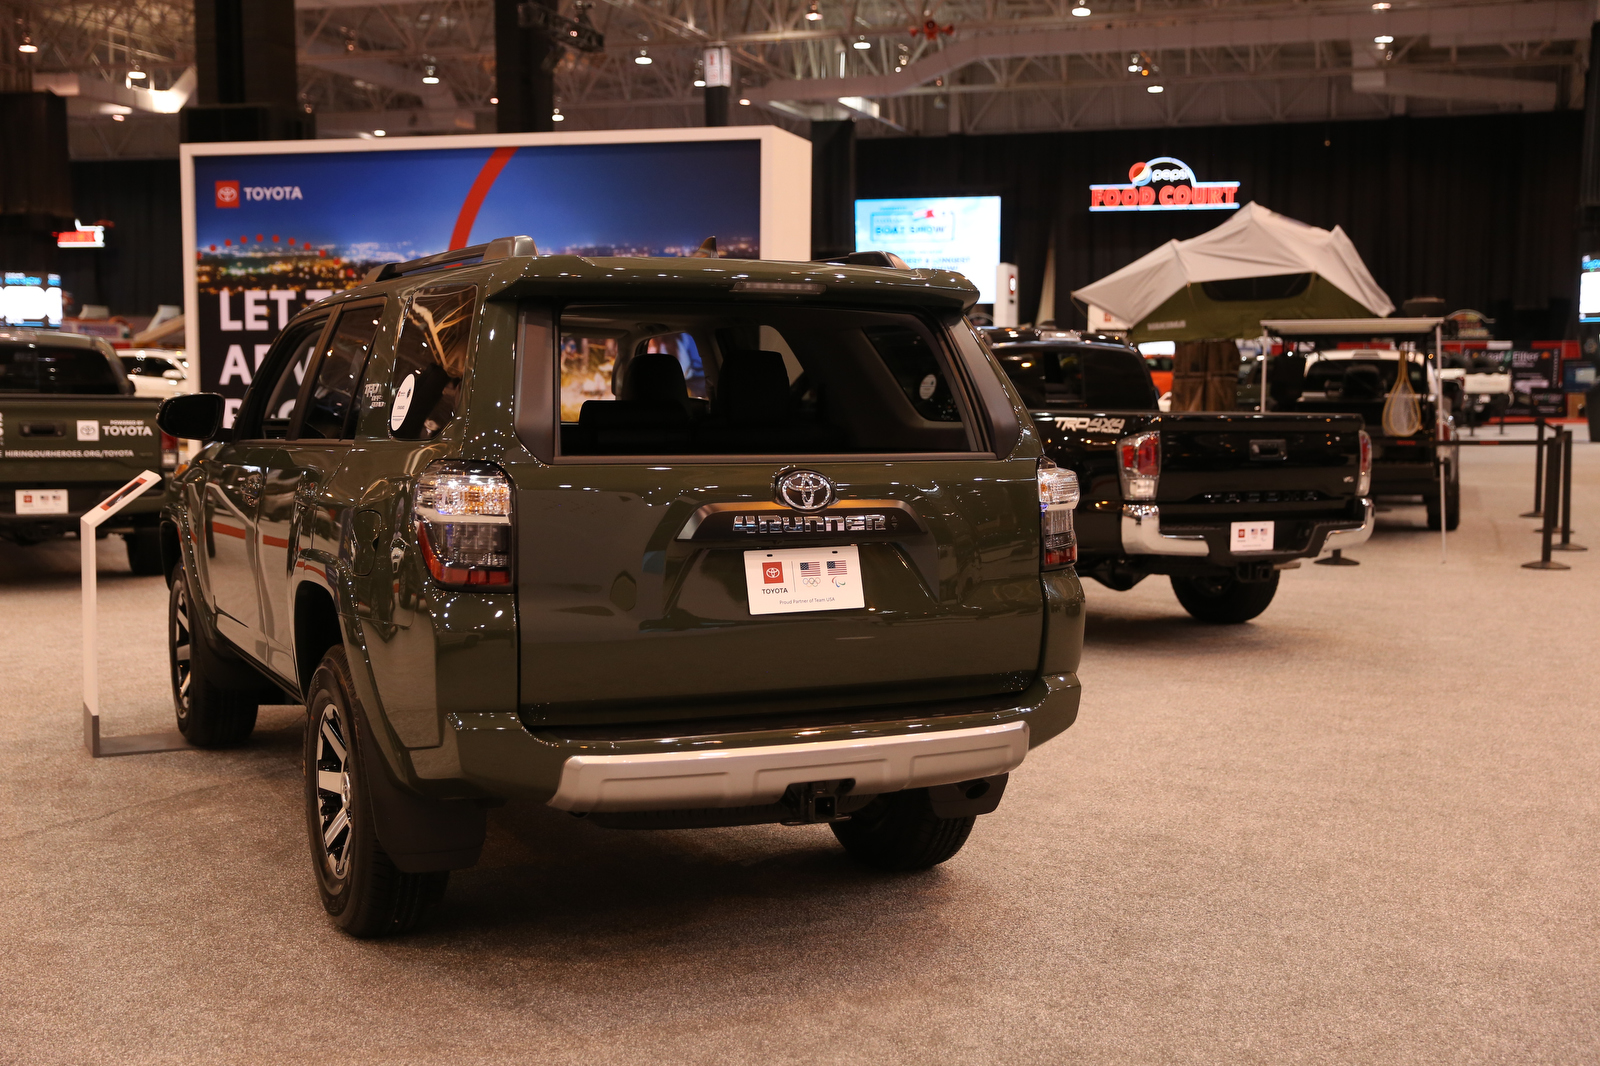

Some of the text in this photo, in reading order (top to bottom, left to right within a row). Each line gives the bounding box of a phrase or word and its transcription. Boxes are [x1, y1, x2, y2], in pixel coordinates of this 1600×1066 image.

[243, 186, 303, 201] TOYOTA
[1091, 184, 1238, 208] FOOD COURT
[219, 289, 297, 331] LET
[102, 425, 153, 437] TOYOTA
[5, 450, 134, 458] HIRINGOURHEROES.ORG/TOYOTA
